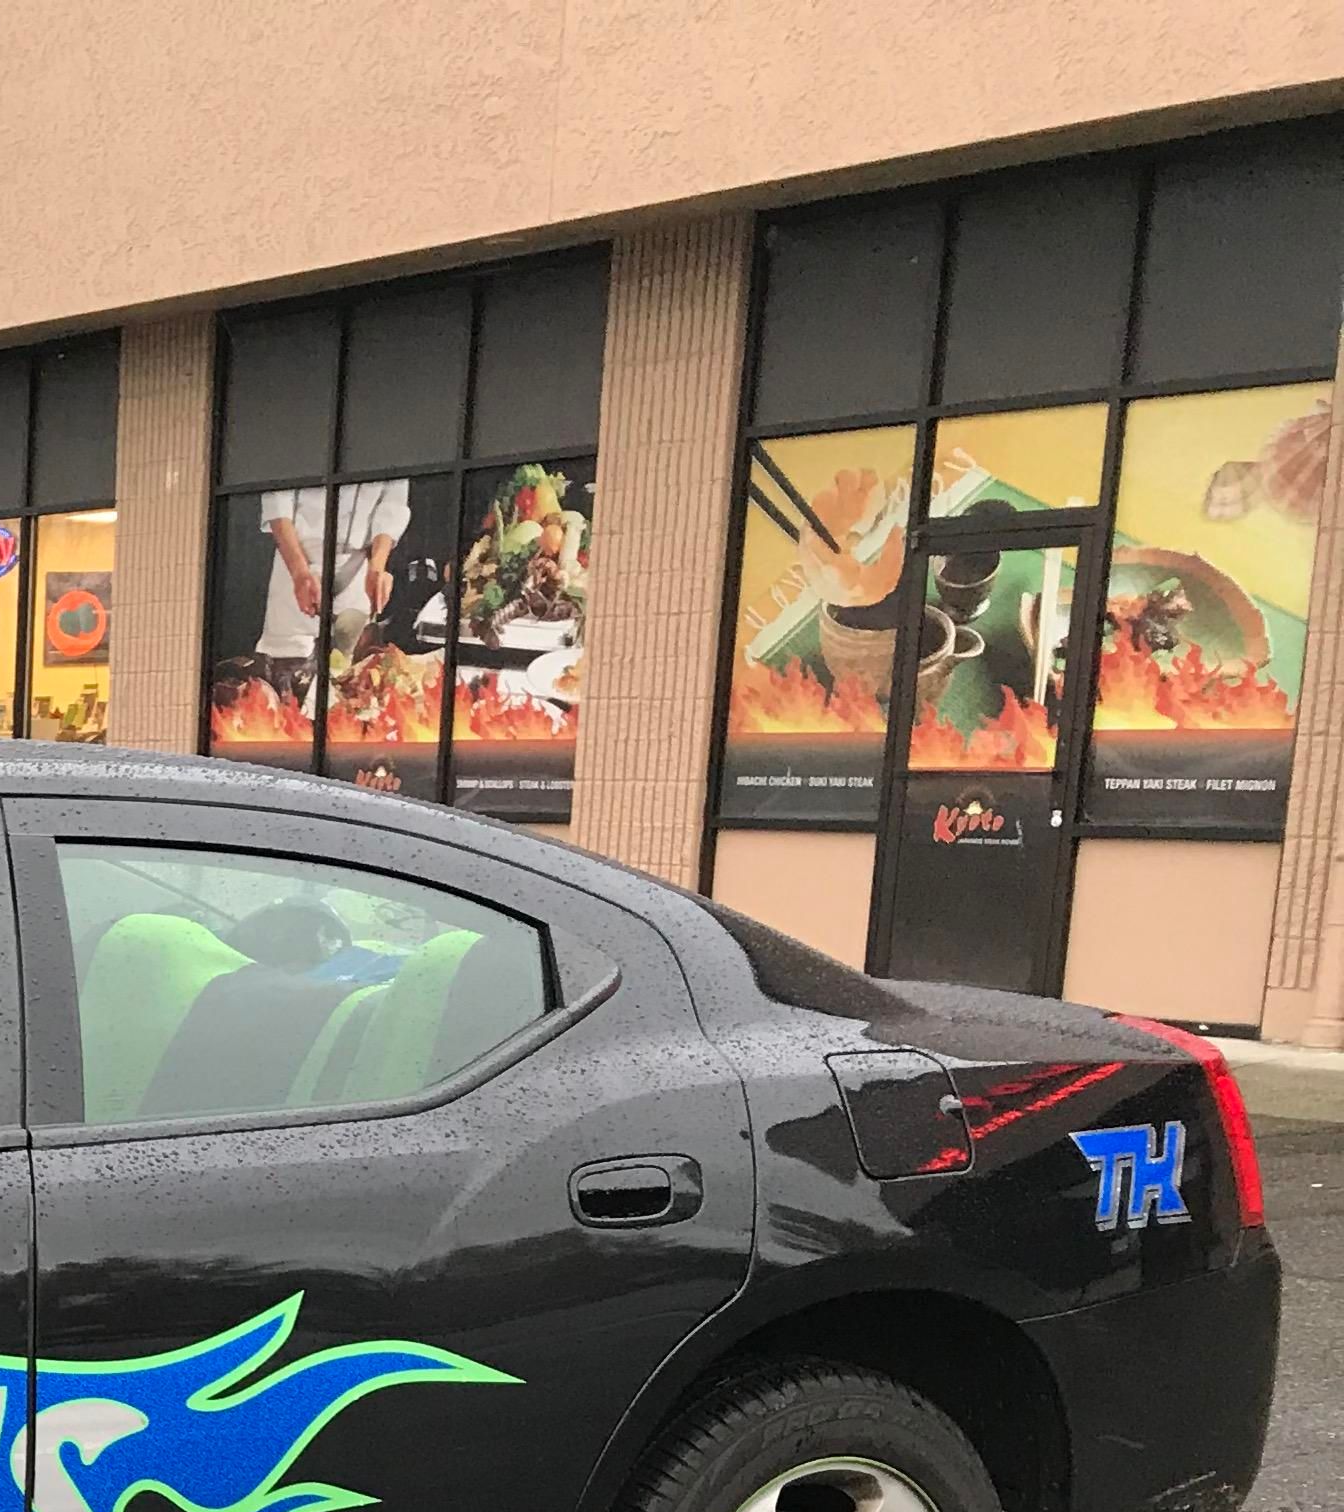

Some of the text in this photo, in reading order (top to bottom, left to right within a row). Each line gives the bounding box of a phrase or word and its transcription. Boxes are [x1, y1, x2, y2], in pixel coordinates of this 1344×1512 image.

[1104, 778, 1141, 790] TEPPAN
[1165, 778, 1198, 791] STEAK
[1205, 779, 1234, 791] FILET
[1068, 1119, 1193, 1231] TH
